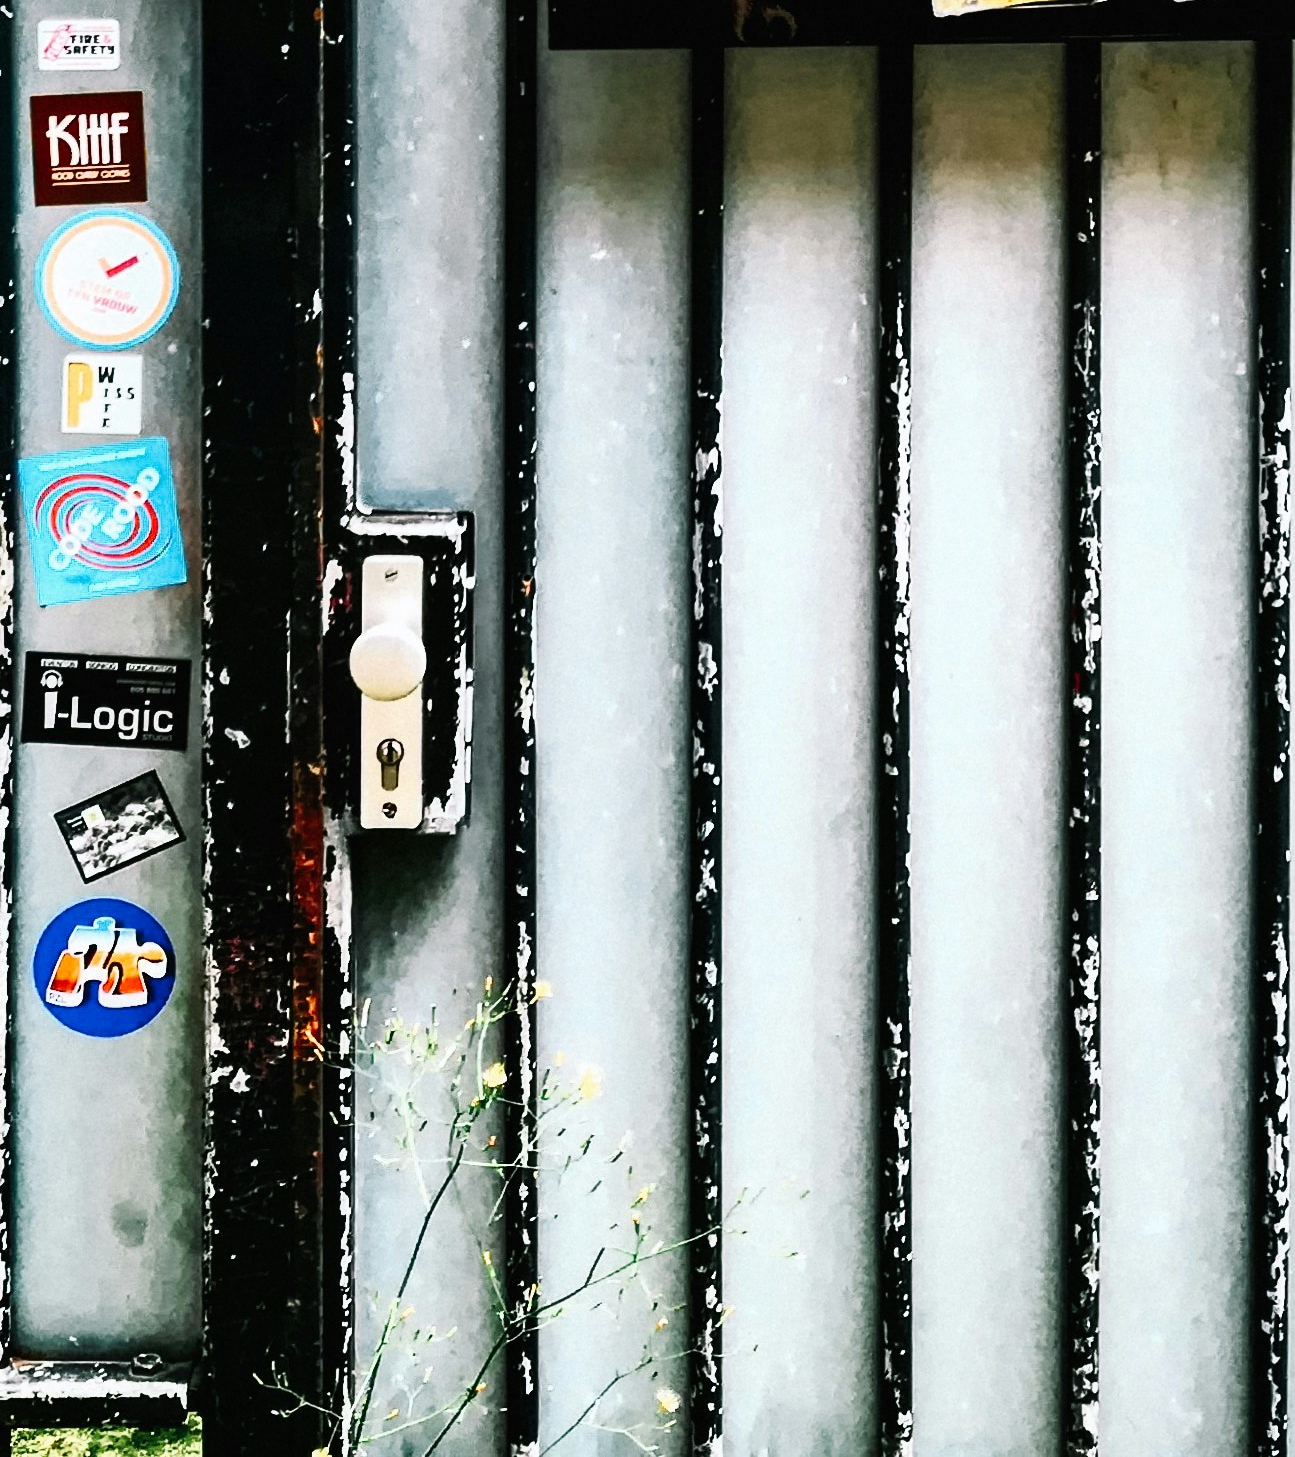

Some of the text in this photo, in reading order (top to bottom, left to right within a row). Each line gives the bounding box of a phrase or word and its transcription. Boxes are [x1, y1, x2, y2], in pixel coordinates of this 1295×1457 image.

[64, 45, 115, 55] SAFETY
[92, 296, 138, 315] VROUW
[49, 467, 160, 571] CODE ROOD
